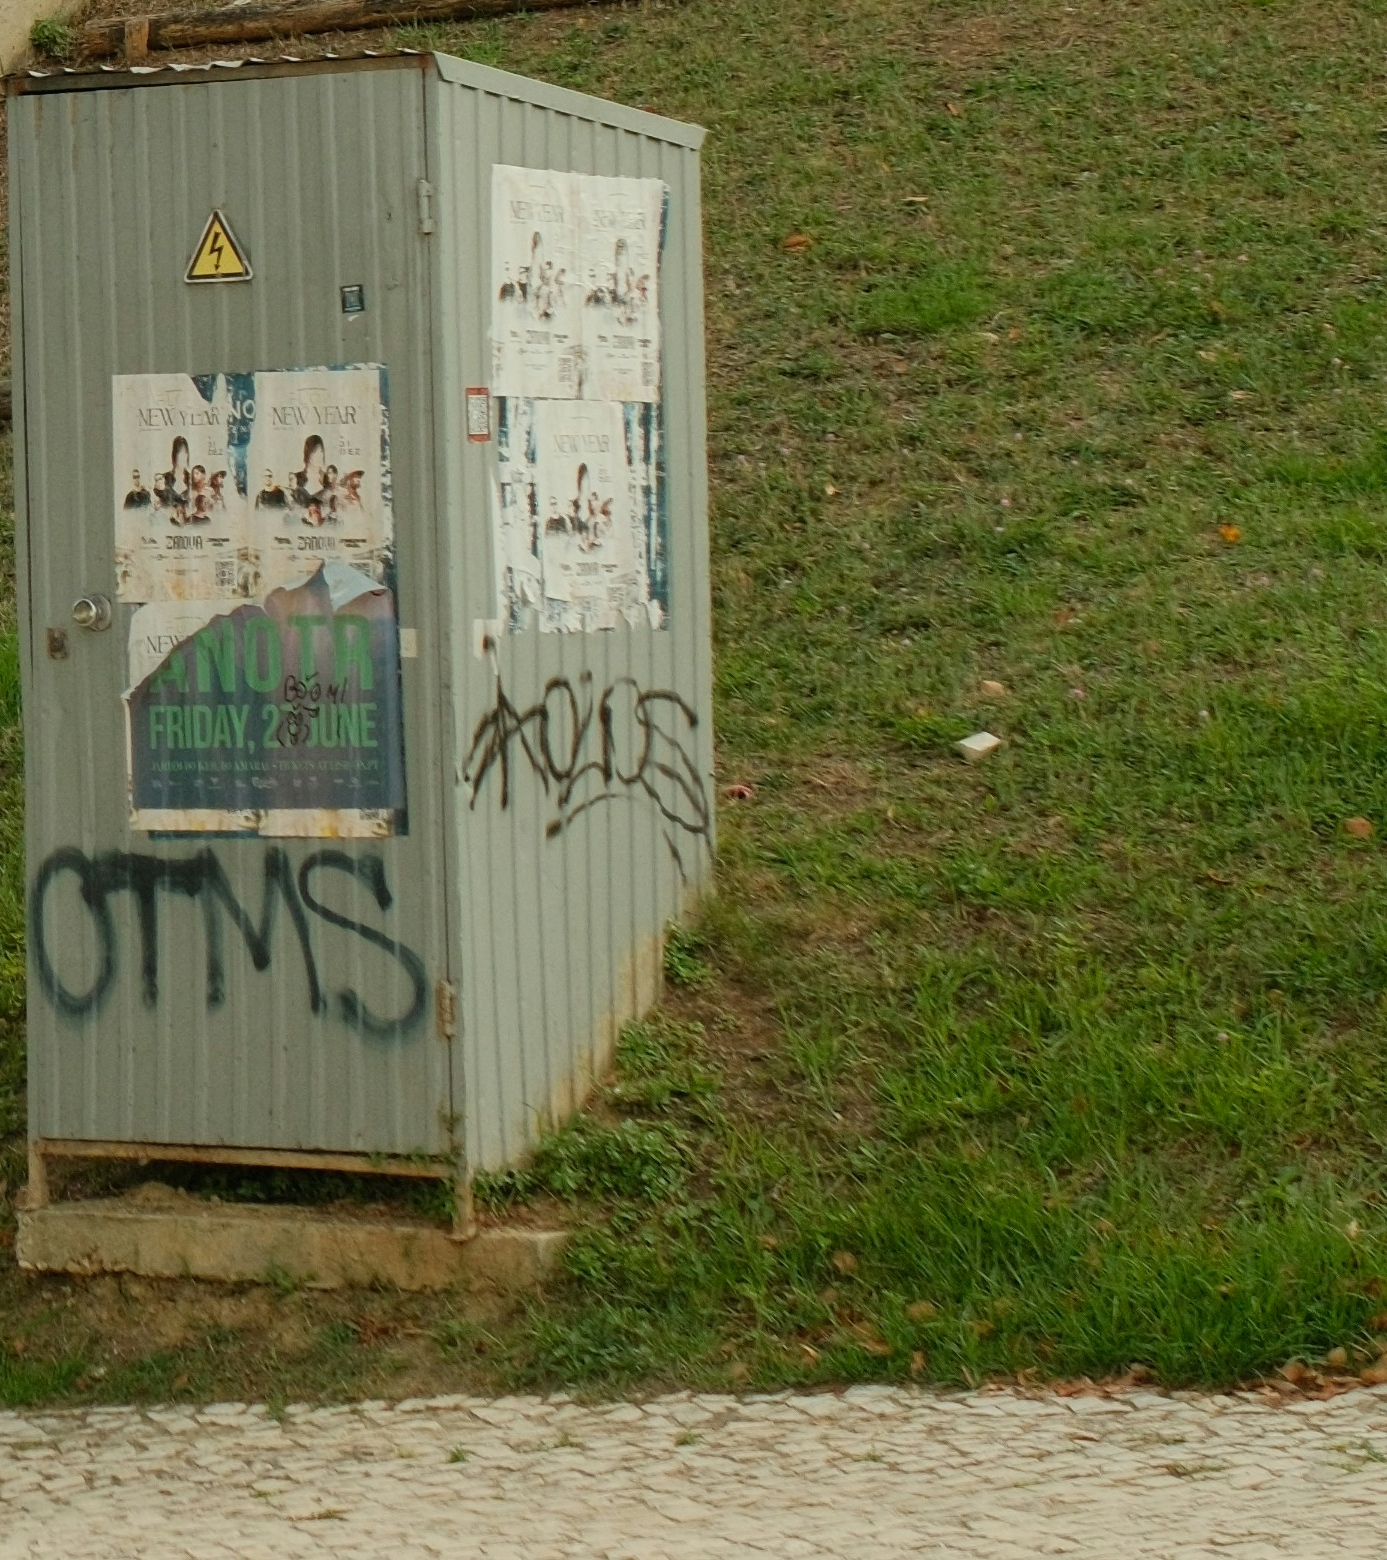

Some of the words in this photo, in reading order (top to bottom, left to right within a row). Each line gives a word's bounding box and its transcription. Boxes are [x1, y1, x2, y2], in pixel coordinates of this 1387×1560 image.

[138, 407, 174, 426] NEW
[271, 405, 308, 426] NEW
[312, 405, 358, 425] YEAR
[149, 704, 255, 755] FRIDAY,
[307, 703, 378, 749] JUNE
